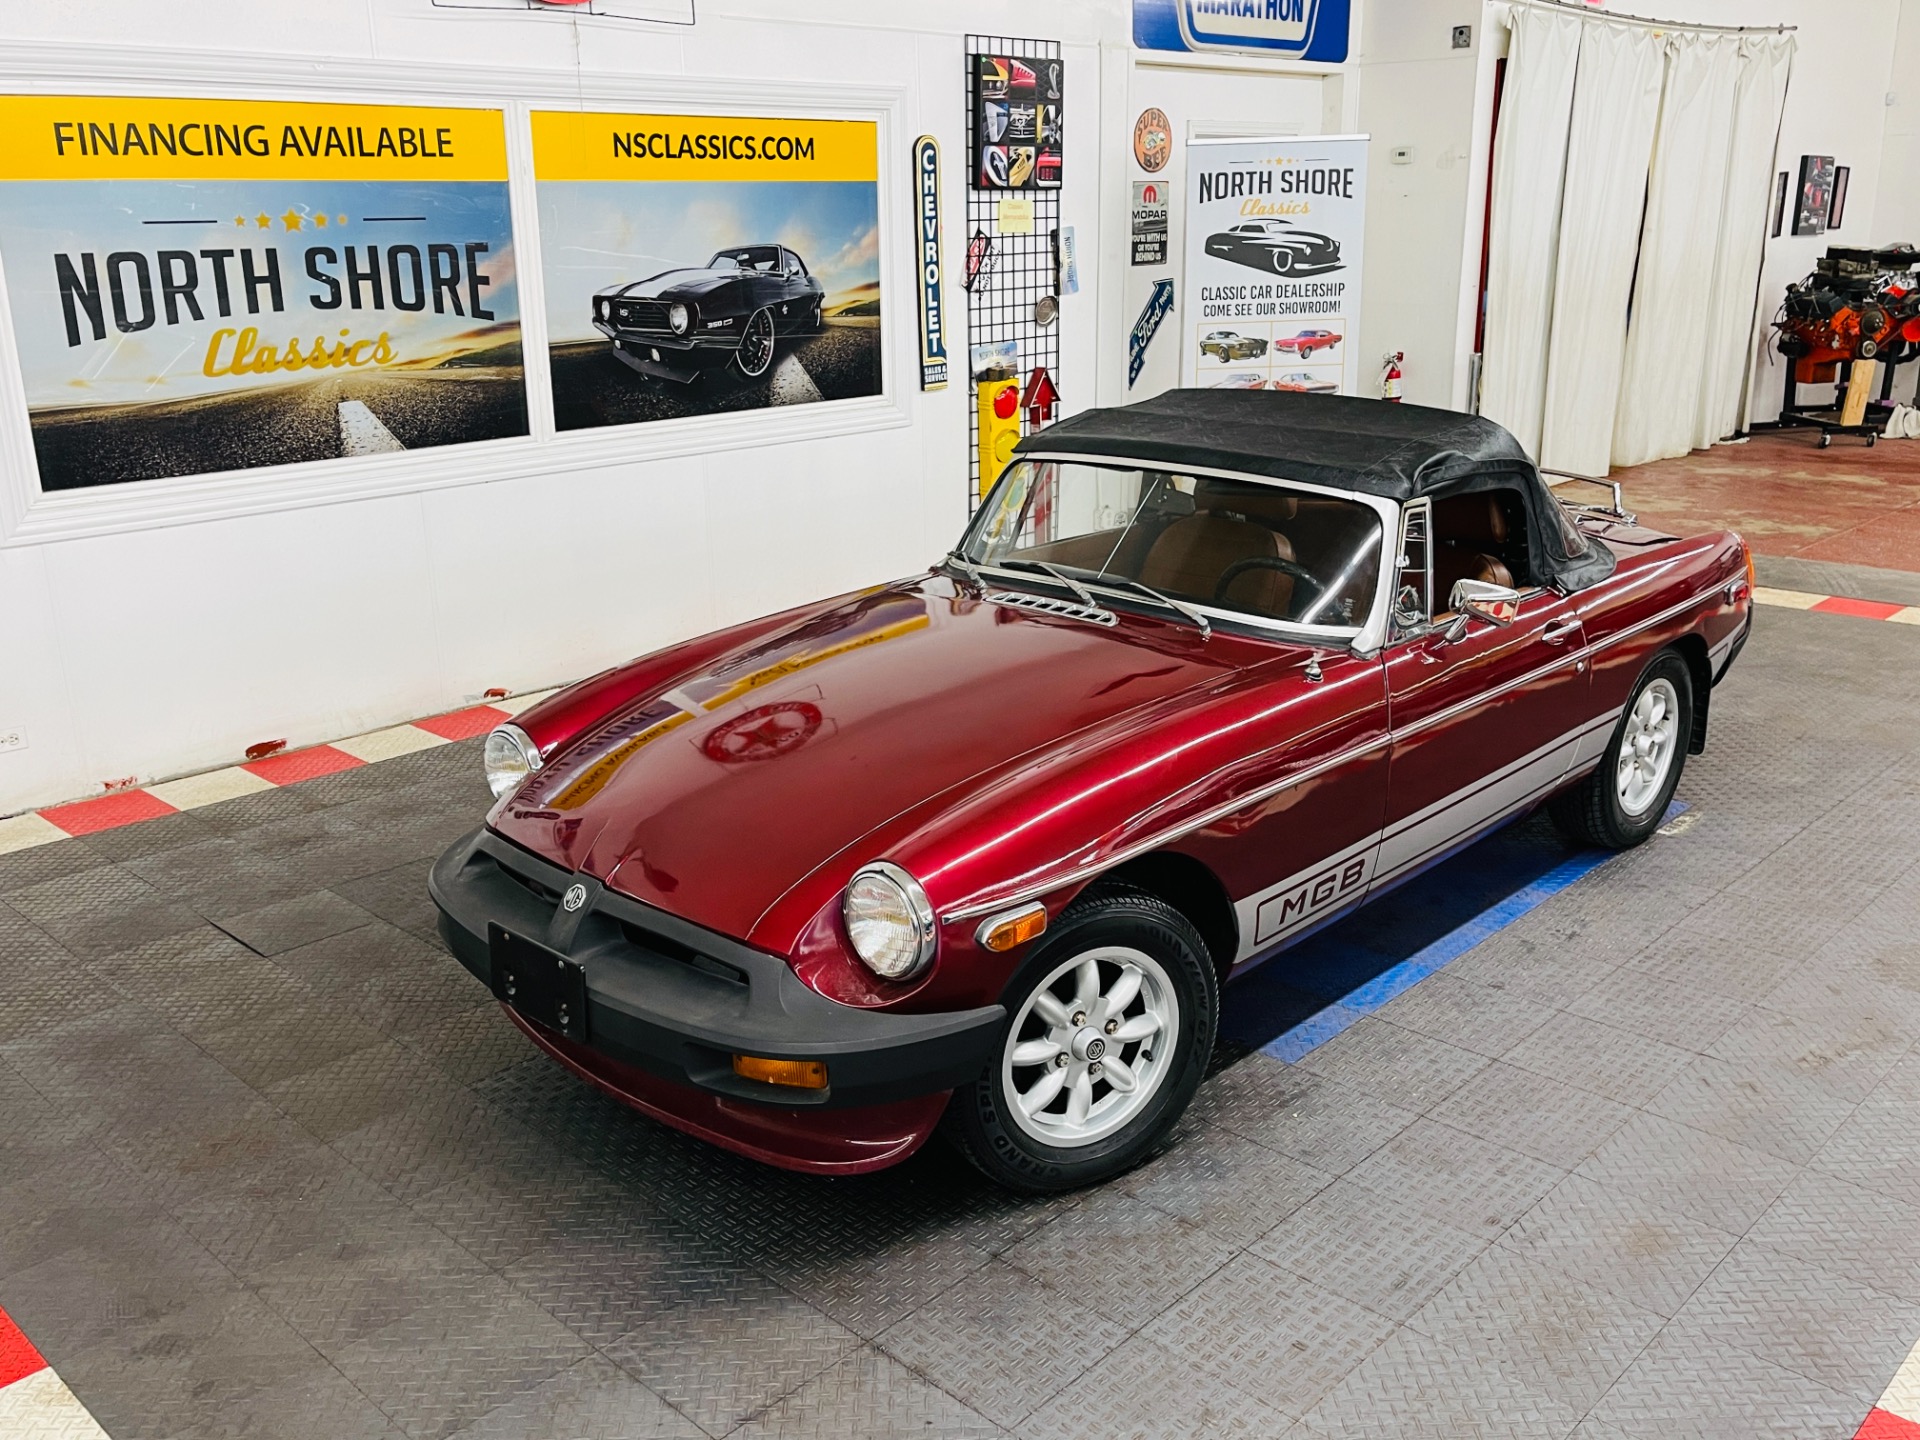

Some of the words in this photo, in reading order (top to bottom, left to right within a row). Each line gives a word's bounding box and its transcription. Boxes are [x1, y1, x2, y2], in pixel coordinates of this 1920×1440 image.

[53, 122, 269, 157] FINANCING
[280, 126, 454, 158] AVAILABLE
[1138, 111, 1168, 144] SUPER
[613, 132, 815, 160] NSCLASSICS.COM
[1143, 146, 1166, 169] BEE
[1199, 171, 1272, 204] NORTH
[1280, 168, 1354, 199] SHORE
[1132, 210, 1167, 219] MOPAR
[1240, 198, 1311, 216] Classics
[922, 150, 939, 353] CHEVROLET
[54, 248, 285, 348] NORTH
[304, 242, 495, 322] SHORE
[1201, 285, 1247, 301] CLASSIC
[1250, 285, 1272, 300] CAR
[1276, 282, 1345, 299] DEALERSHIP
[1203, 304, 1232, 317] COME
[1234, 303, 1253, 316] SEE
[1256, 302, 1276, 316] OUR
[1279, 300, 1341, 315] SHOWROOM!
[1138, 302, 1162, 347] Ford
[203, 327, 398, 379] Classics
[565, 886, 584, 909] MG
[1279, 858, 1365, 925] MGB
[979, 1058, 997, 1124] SPIR
[993, 1135, 1062, 1178] GRAND
